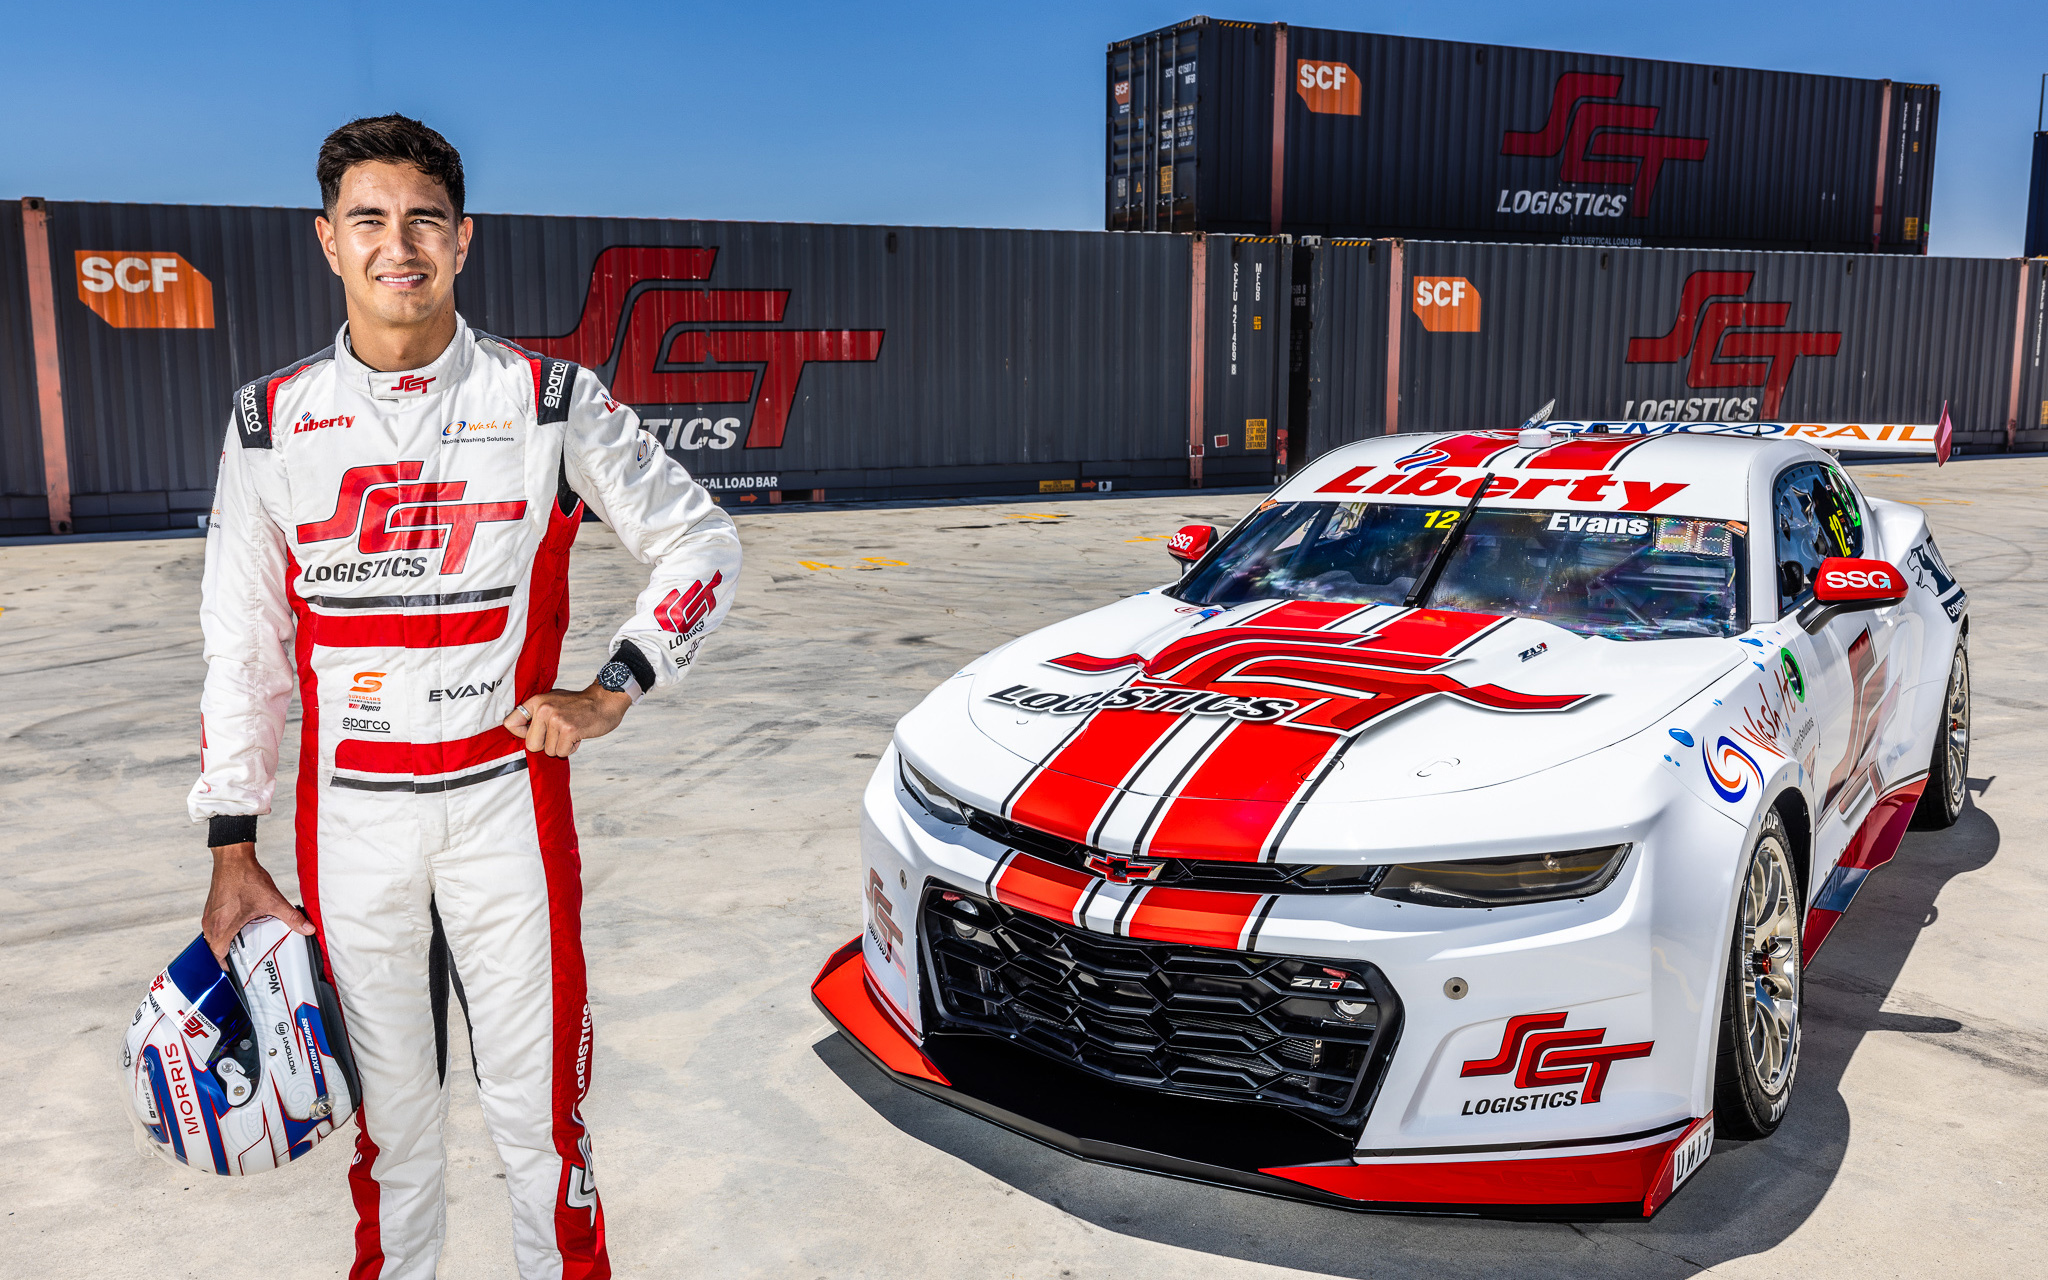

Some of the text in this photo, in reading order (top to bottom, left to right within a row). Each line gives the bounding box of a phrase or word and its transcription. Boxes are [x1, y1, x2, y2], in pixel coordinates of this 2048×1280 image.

[1300, 63, 1346, 90] SCF
[1115, 83, 1128, 96] SCF
[1497, 189, 1627, 217] LOGISTICS
[1583, 237, 1612, 246] VERTICAL
[1613, 237, 1629, 246] LOAD
[1630, 238, 1642, 246] BAR
[81, 256, 178, 293] SCF
[1416, 281, 1465, 307] SCF
[544, 361, 569, 408] sparco
[240, 384, 262, 435] sparco
[1623, 397, 1758, 422] LOGISTICS
[294, 412, 356, 434] Liberty
[468, 420, 513, 432] Wash It
[725, 477, 754, 489] LOAD
[756, 476, 778, 488] BAR
[1314, 464, 1690, 511] Liberty
[1424, 510, 1650, 535] 12 Evans
[1169, 532, 1194, 550] SSG
[304, 557, 428, 583] LOGISTICS
[1825, 570, 1892, 589] SSG
[348, 694, 381, 702] SUPERCARS
[360, 703, 381, 712] Repco
[990, 684, 1298, 721] LOGISTICS
[342, 717, 391, 733] sparco
[264, 960, 281, 995] Wade
[1290, 977, 1343, 990] ZL1
[301, 1017, 322, 1075] JAXON EVANS
[165, 1042, 201, 1135] MORRIS
[1461, 1090, 1579, 1117] LOGISTICS
